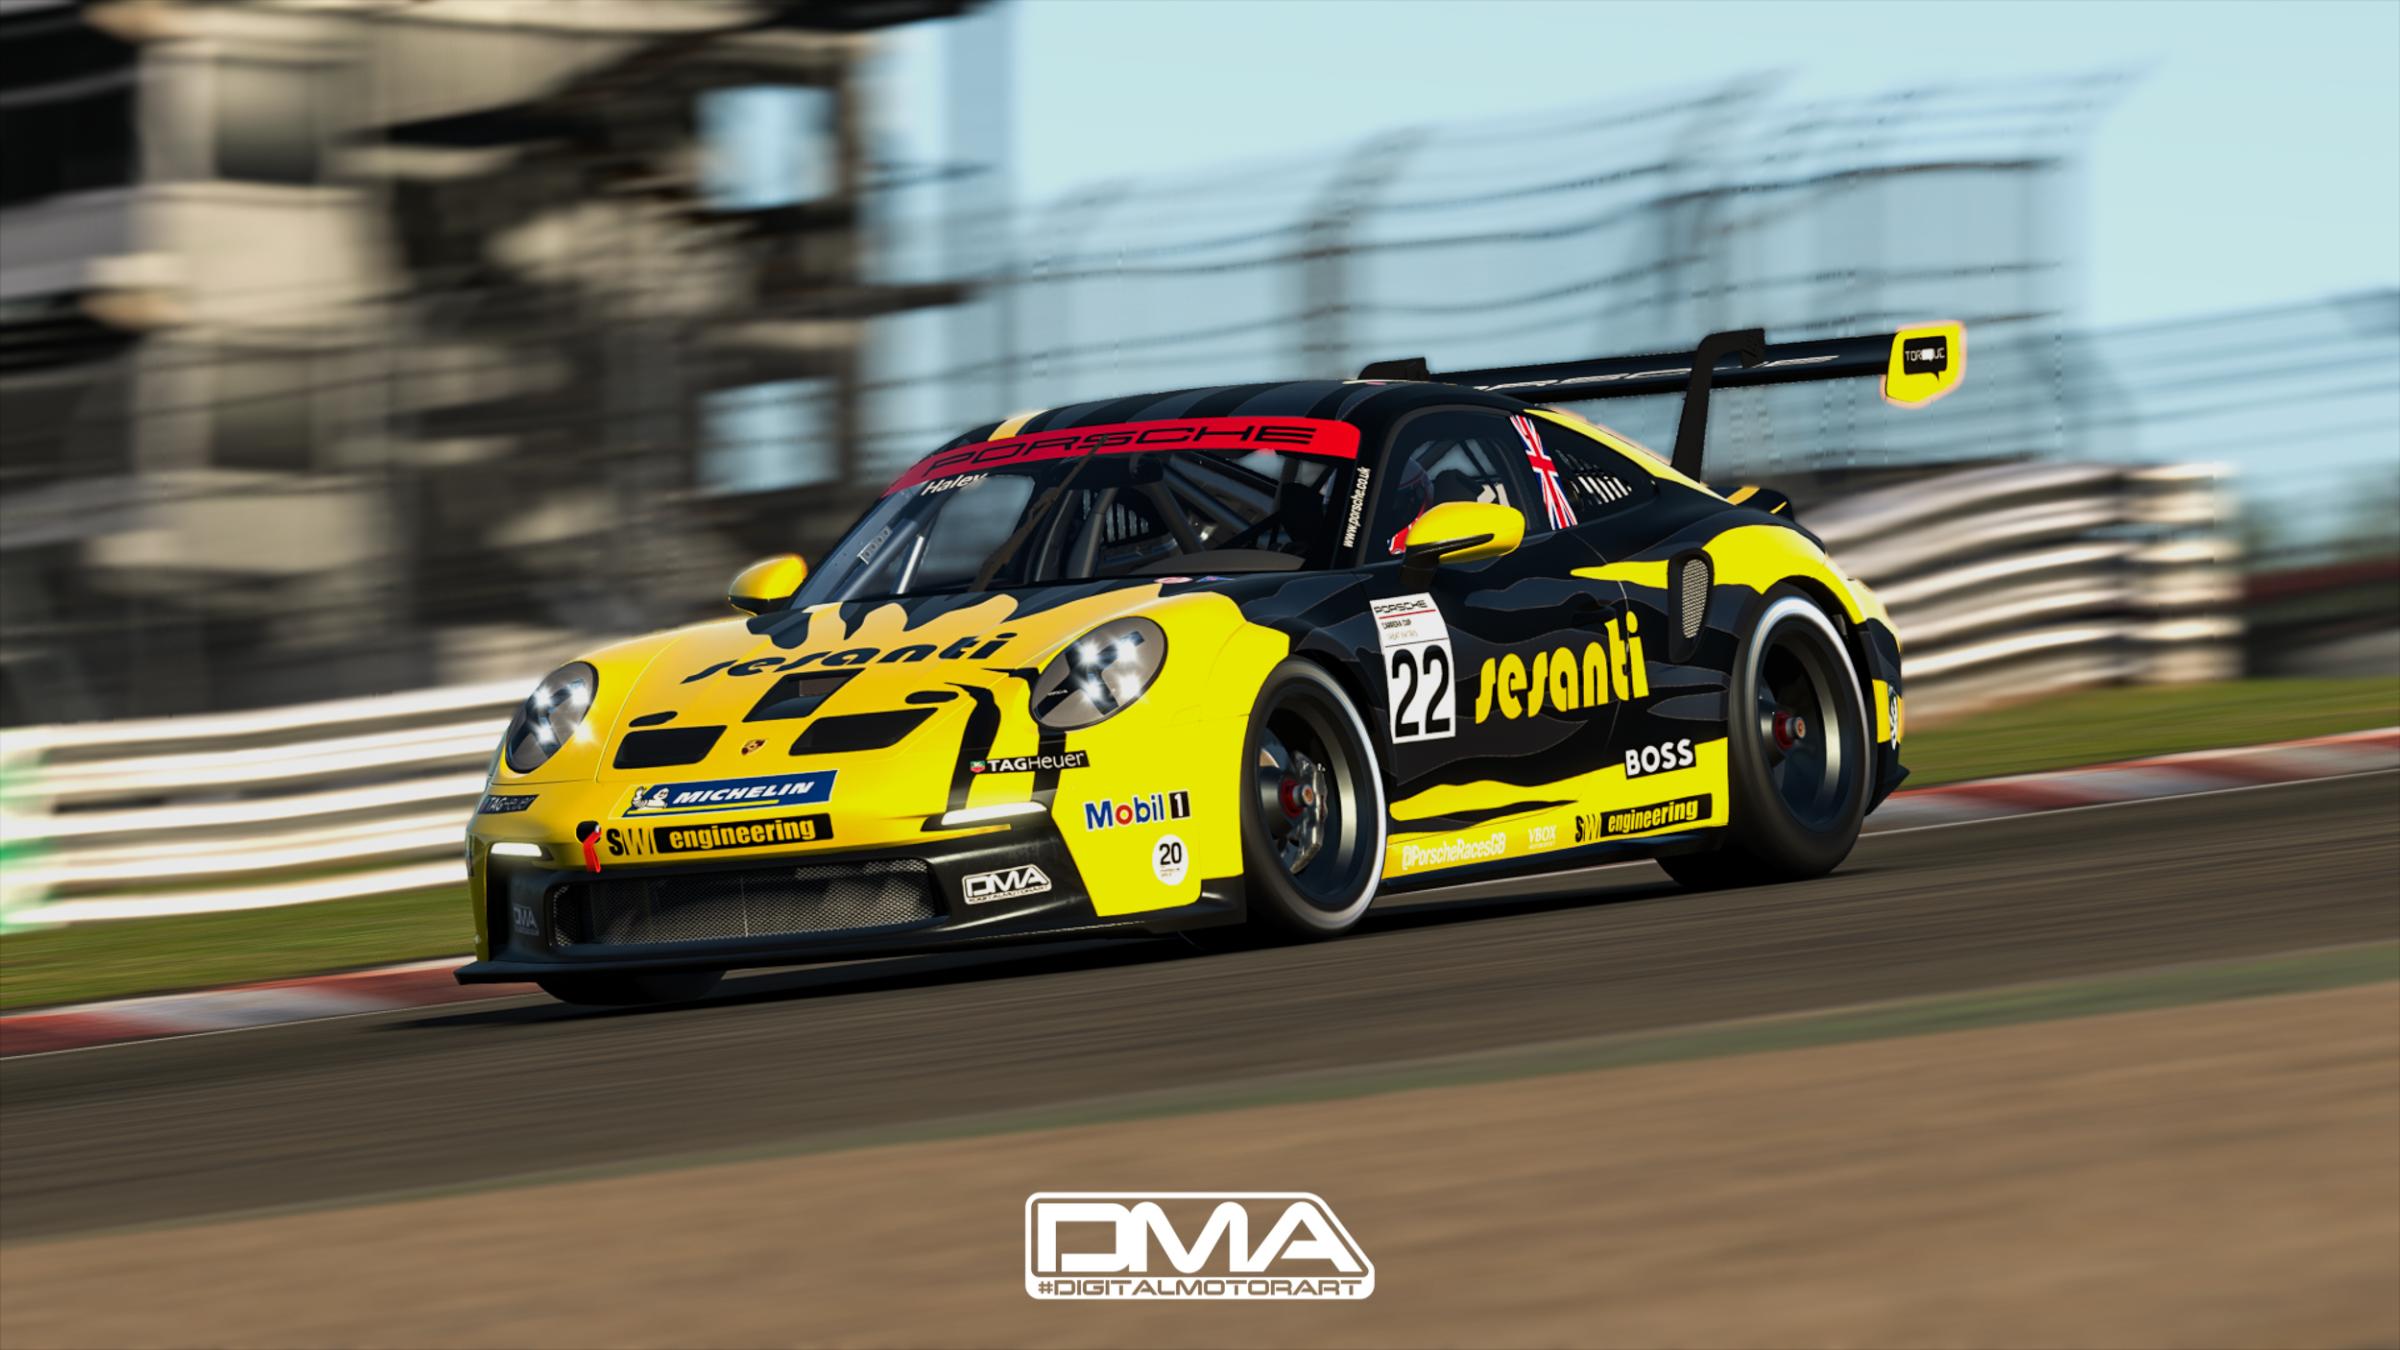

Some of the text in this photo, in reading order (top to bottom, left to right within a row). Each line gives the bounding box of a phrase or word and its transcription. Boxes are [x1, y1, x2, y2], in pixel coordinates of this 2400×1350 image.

[921, 425, 1317, 477] PORSCHE
[920, 472, 989, 496] Haley
[1343, 466, 1371, 548] www.porsche.co.uk
[1374, 600, 1428, 613] PORSCHE
[680, 632, 1018, 684] sesanti
[1475, 610, 1649, 724] sesanti
[1391, 644, 1450, 738] 22
[1625, 738, 1693, 776] BOSS
[672, 781, 815, 804] MICHELIN
[1085, 793, 1185, 830] Mobil 1
[1608, 800, 1698, 833] engineering
[669, 819, 817, 850] engineering
[1401, 832, 1506, 870] @PorscheRacesGB
[1528, 825, 1557, 843] VBOX
[1159, 842, 1182, 865] 20
[966, 867, 1048, 897] DMA
